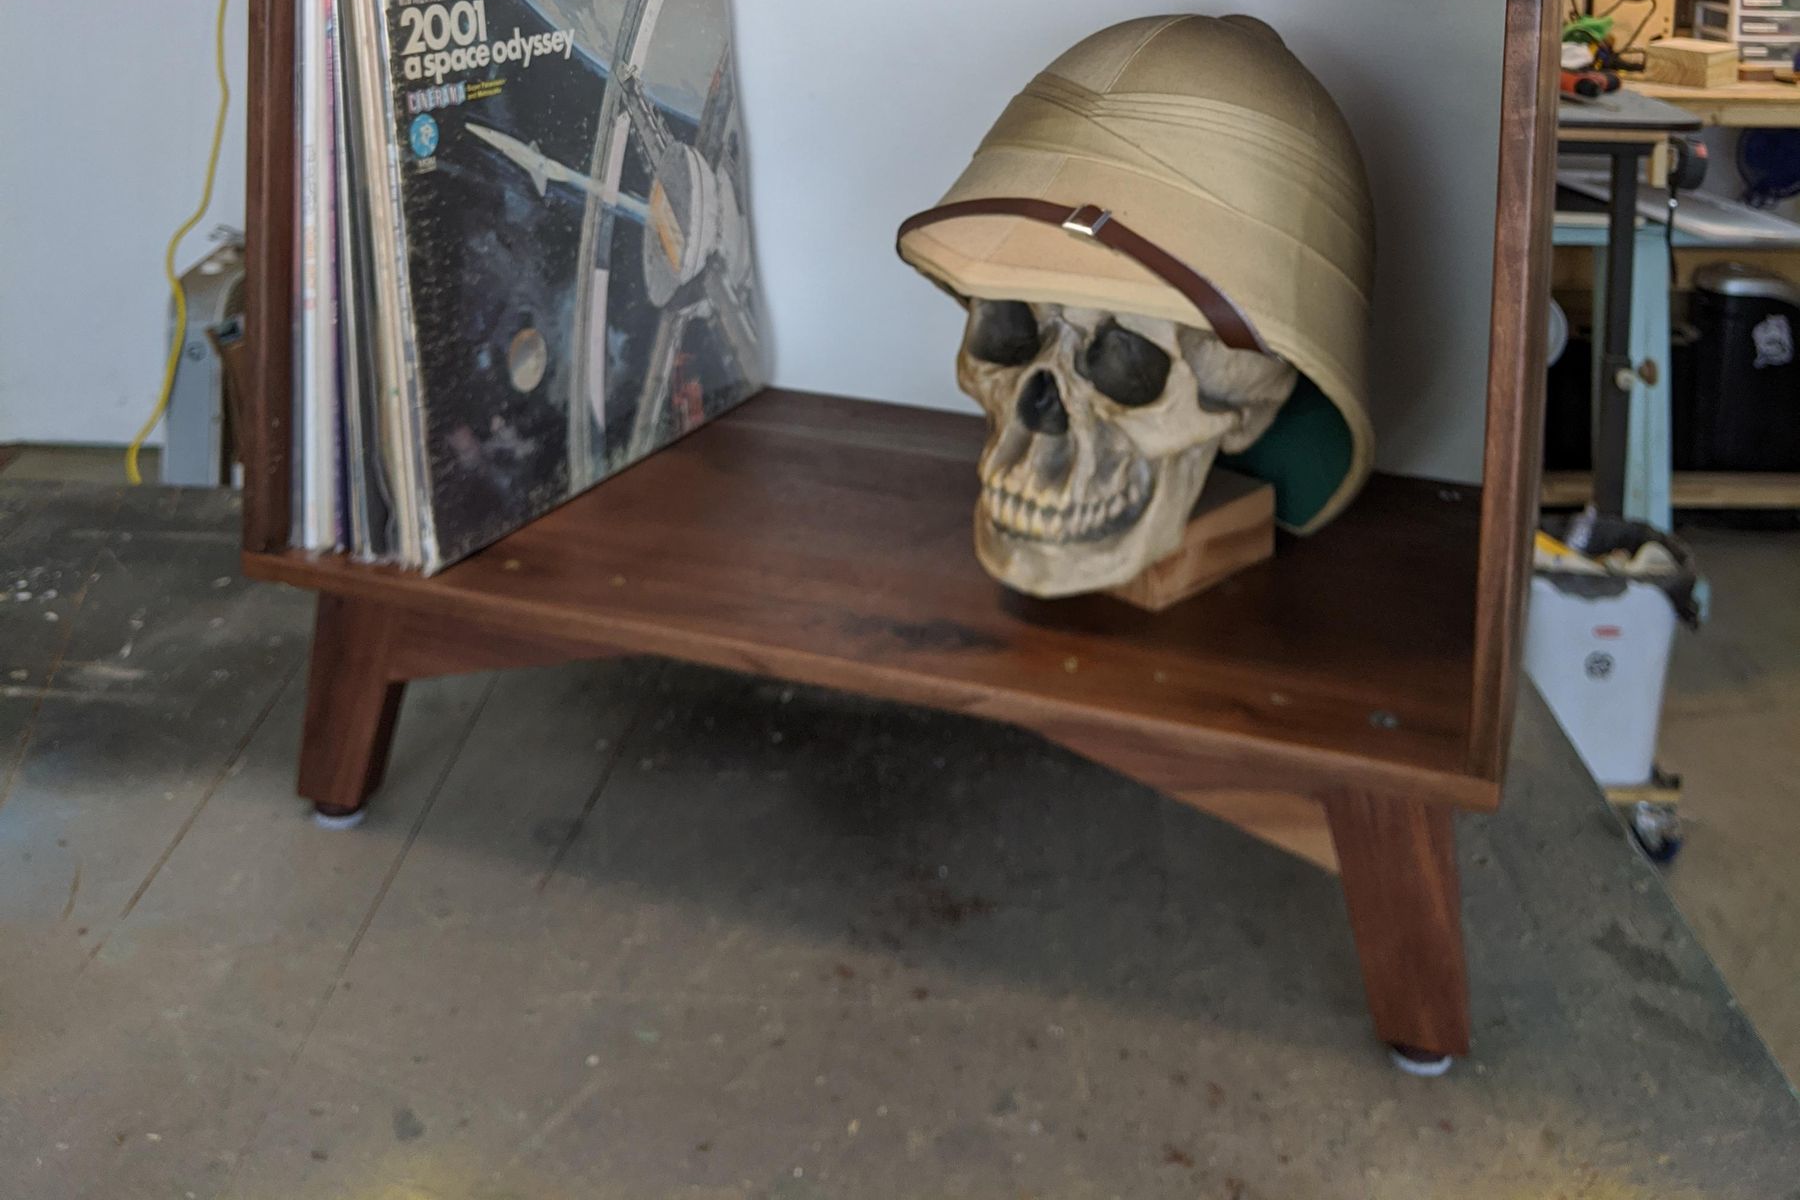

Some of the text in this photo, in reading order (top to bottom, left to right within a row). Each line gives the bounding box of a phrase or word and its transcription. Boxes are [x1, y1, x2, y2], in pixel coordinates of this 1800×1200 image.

[400, 0, 487, 55] 2001
[404, 27, 575, 85] a space odyssey
